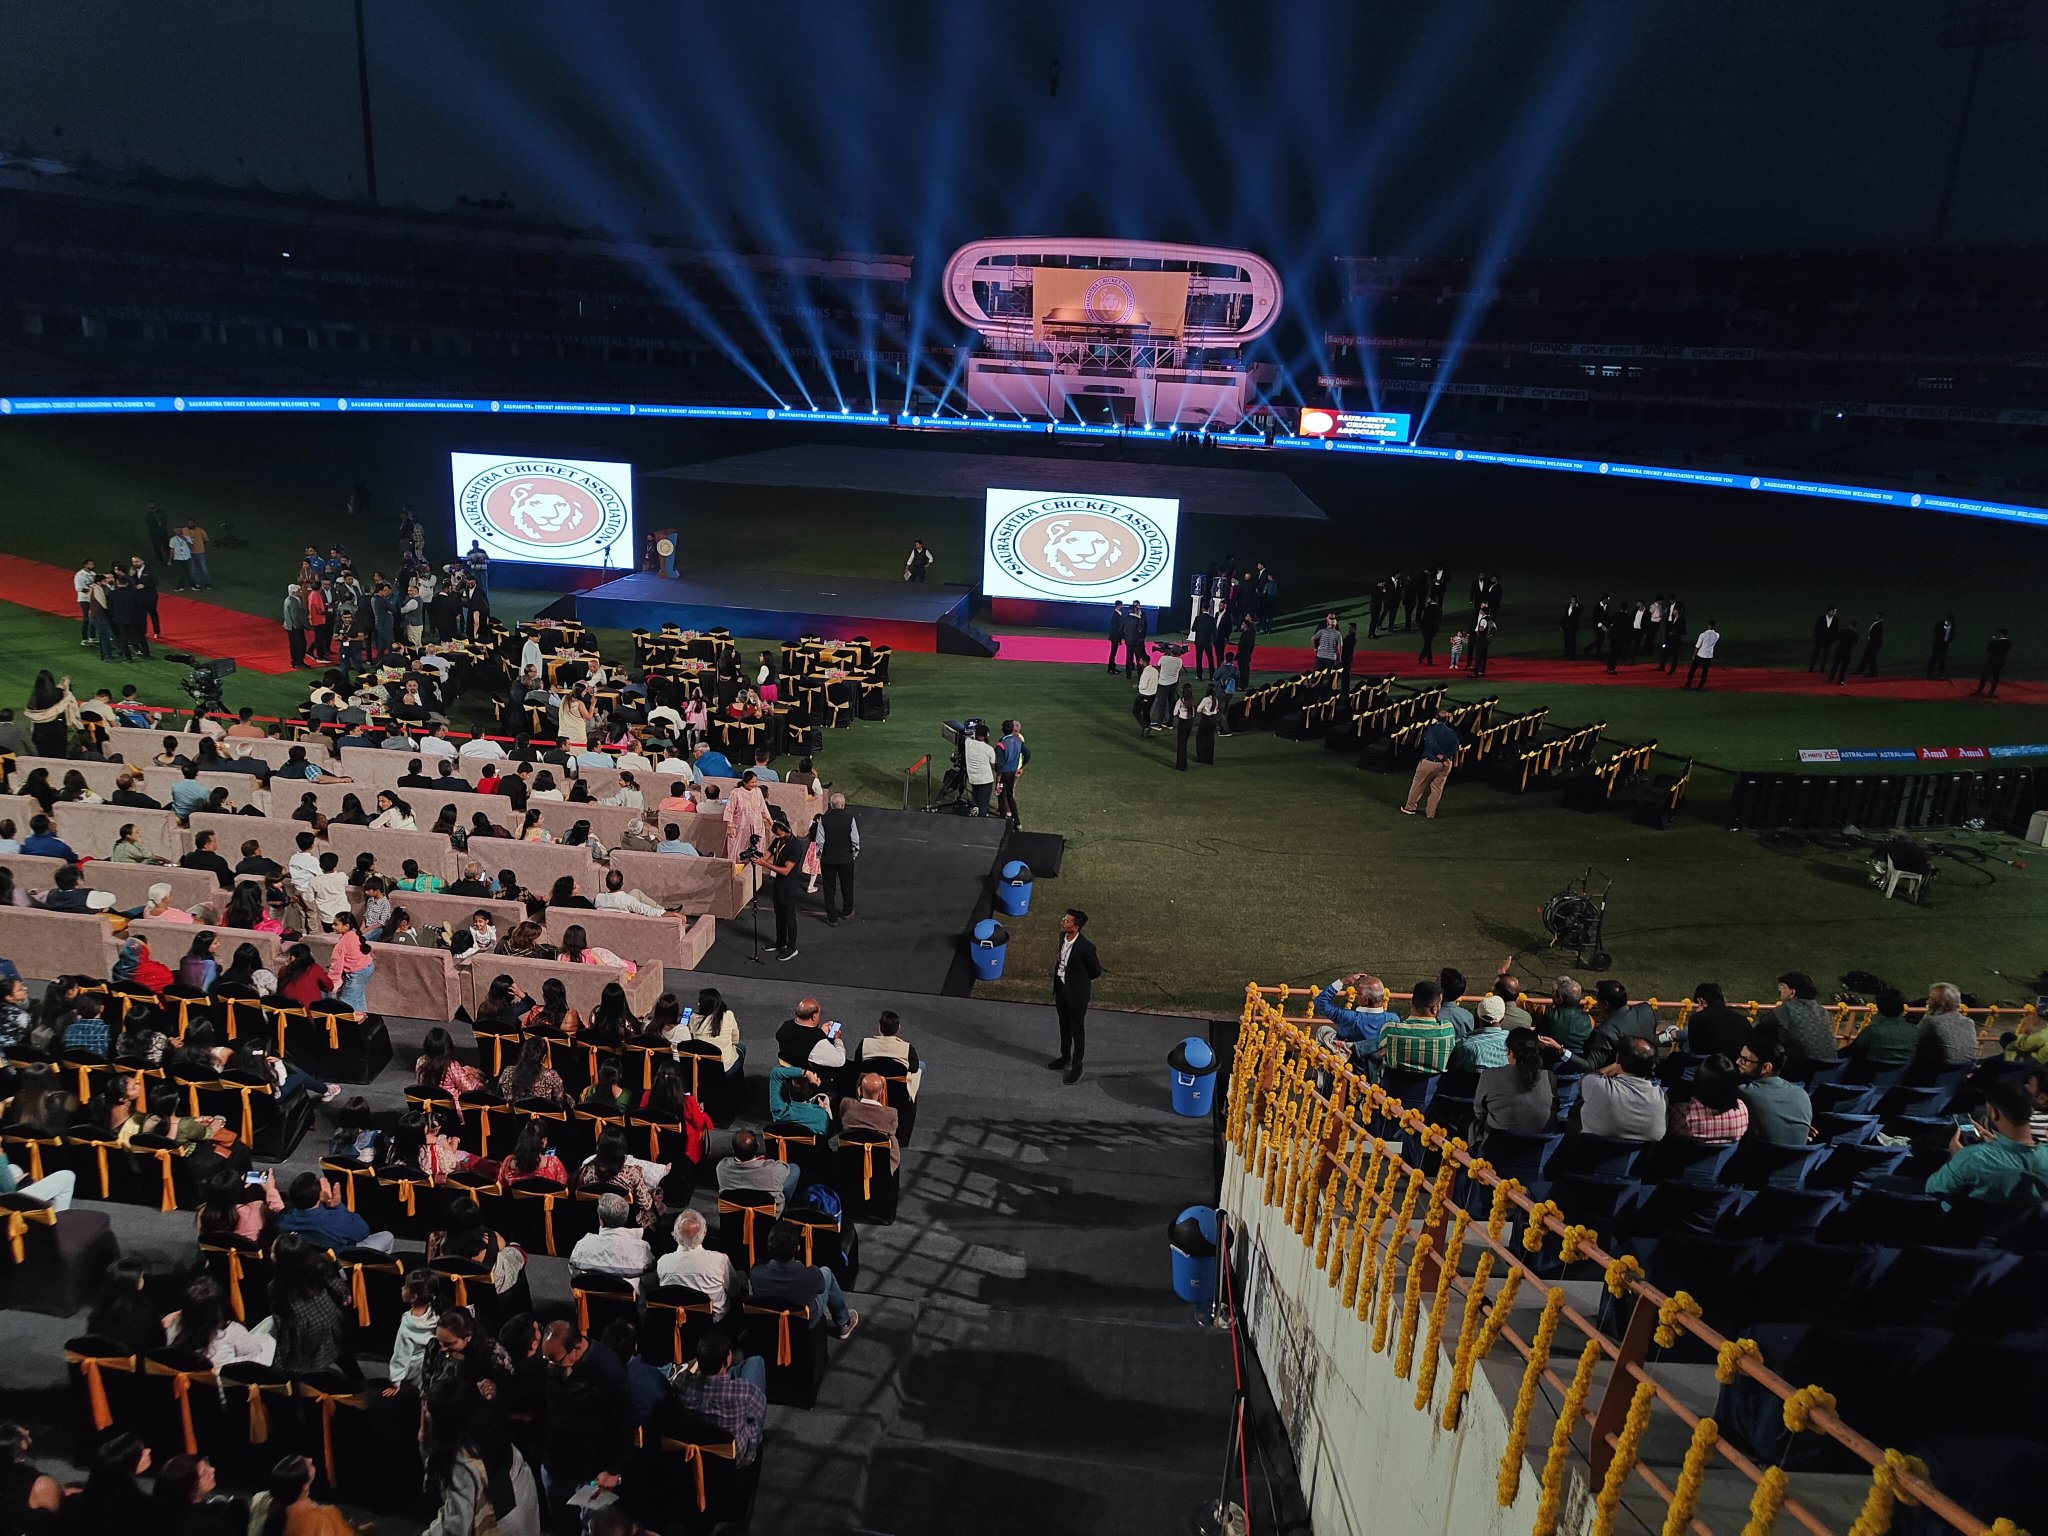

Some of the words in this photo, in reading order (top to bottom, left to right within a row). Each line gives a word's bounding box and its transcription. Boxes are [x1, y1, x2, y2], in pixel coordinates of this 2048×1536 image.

[1337, 414, 1396, 424] SAURASHTRA
[1336, 428, 1396, 436] ASSOCIATION
[467, 472, 502, 533] SAURASHTRA
[504, 464, 578, 478] CRICKET
[579, 477, 621, 542] ASSOCIATION
[1925, 500, 1958, 508] SAURASHTRA
[1982, 506, 2016, 515] ASSOCIATION
[997, 508, 1039, 572] SAURASHTRA
[1042, 500, 1122, 514] CRICKET
[1121, 513, 1162, 580] ASSOCIATION
[1923, 748, 1948, 758] Amul
[1959, 747, 1984, 757] Amul
